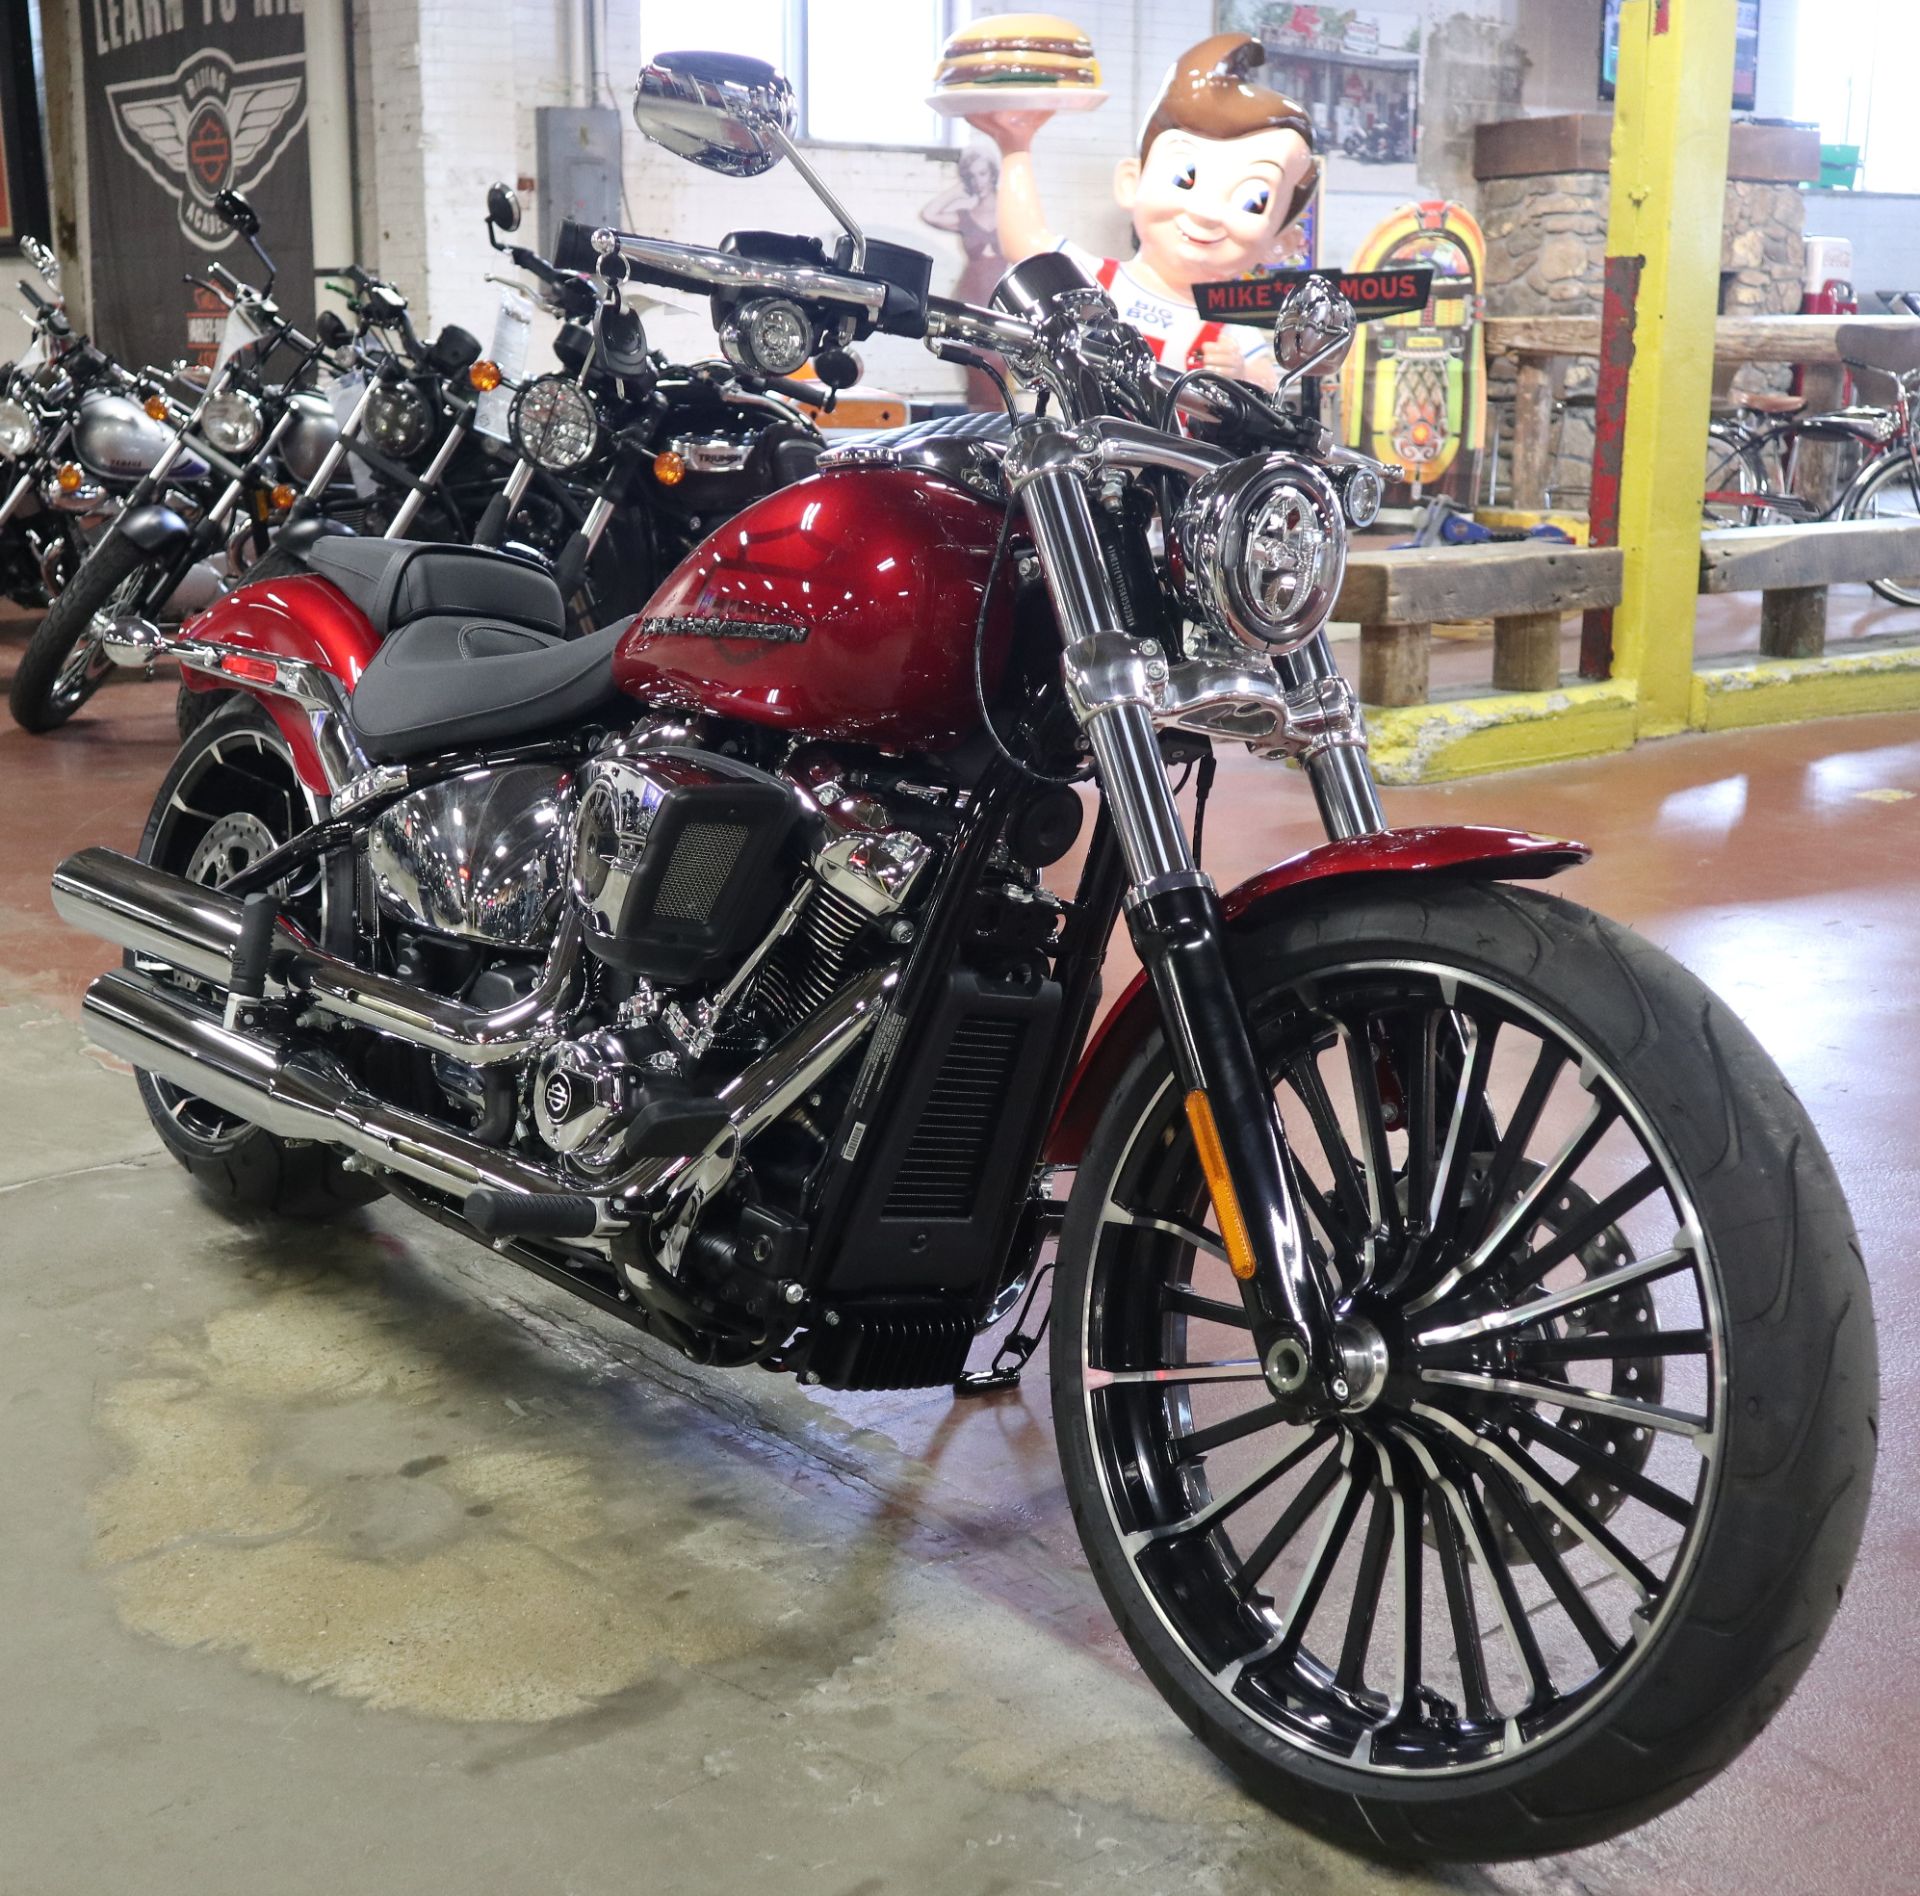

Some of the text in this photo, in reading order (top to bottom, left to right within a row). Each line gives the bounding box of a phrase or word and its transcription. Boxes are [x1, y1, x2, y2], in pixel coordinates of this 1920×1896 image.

[186, 202, 231, 236] ACADE
[1339, 274, 1418, 302] MOUS
[1126, 307, 1175, 329] BOY
